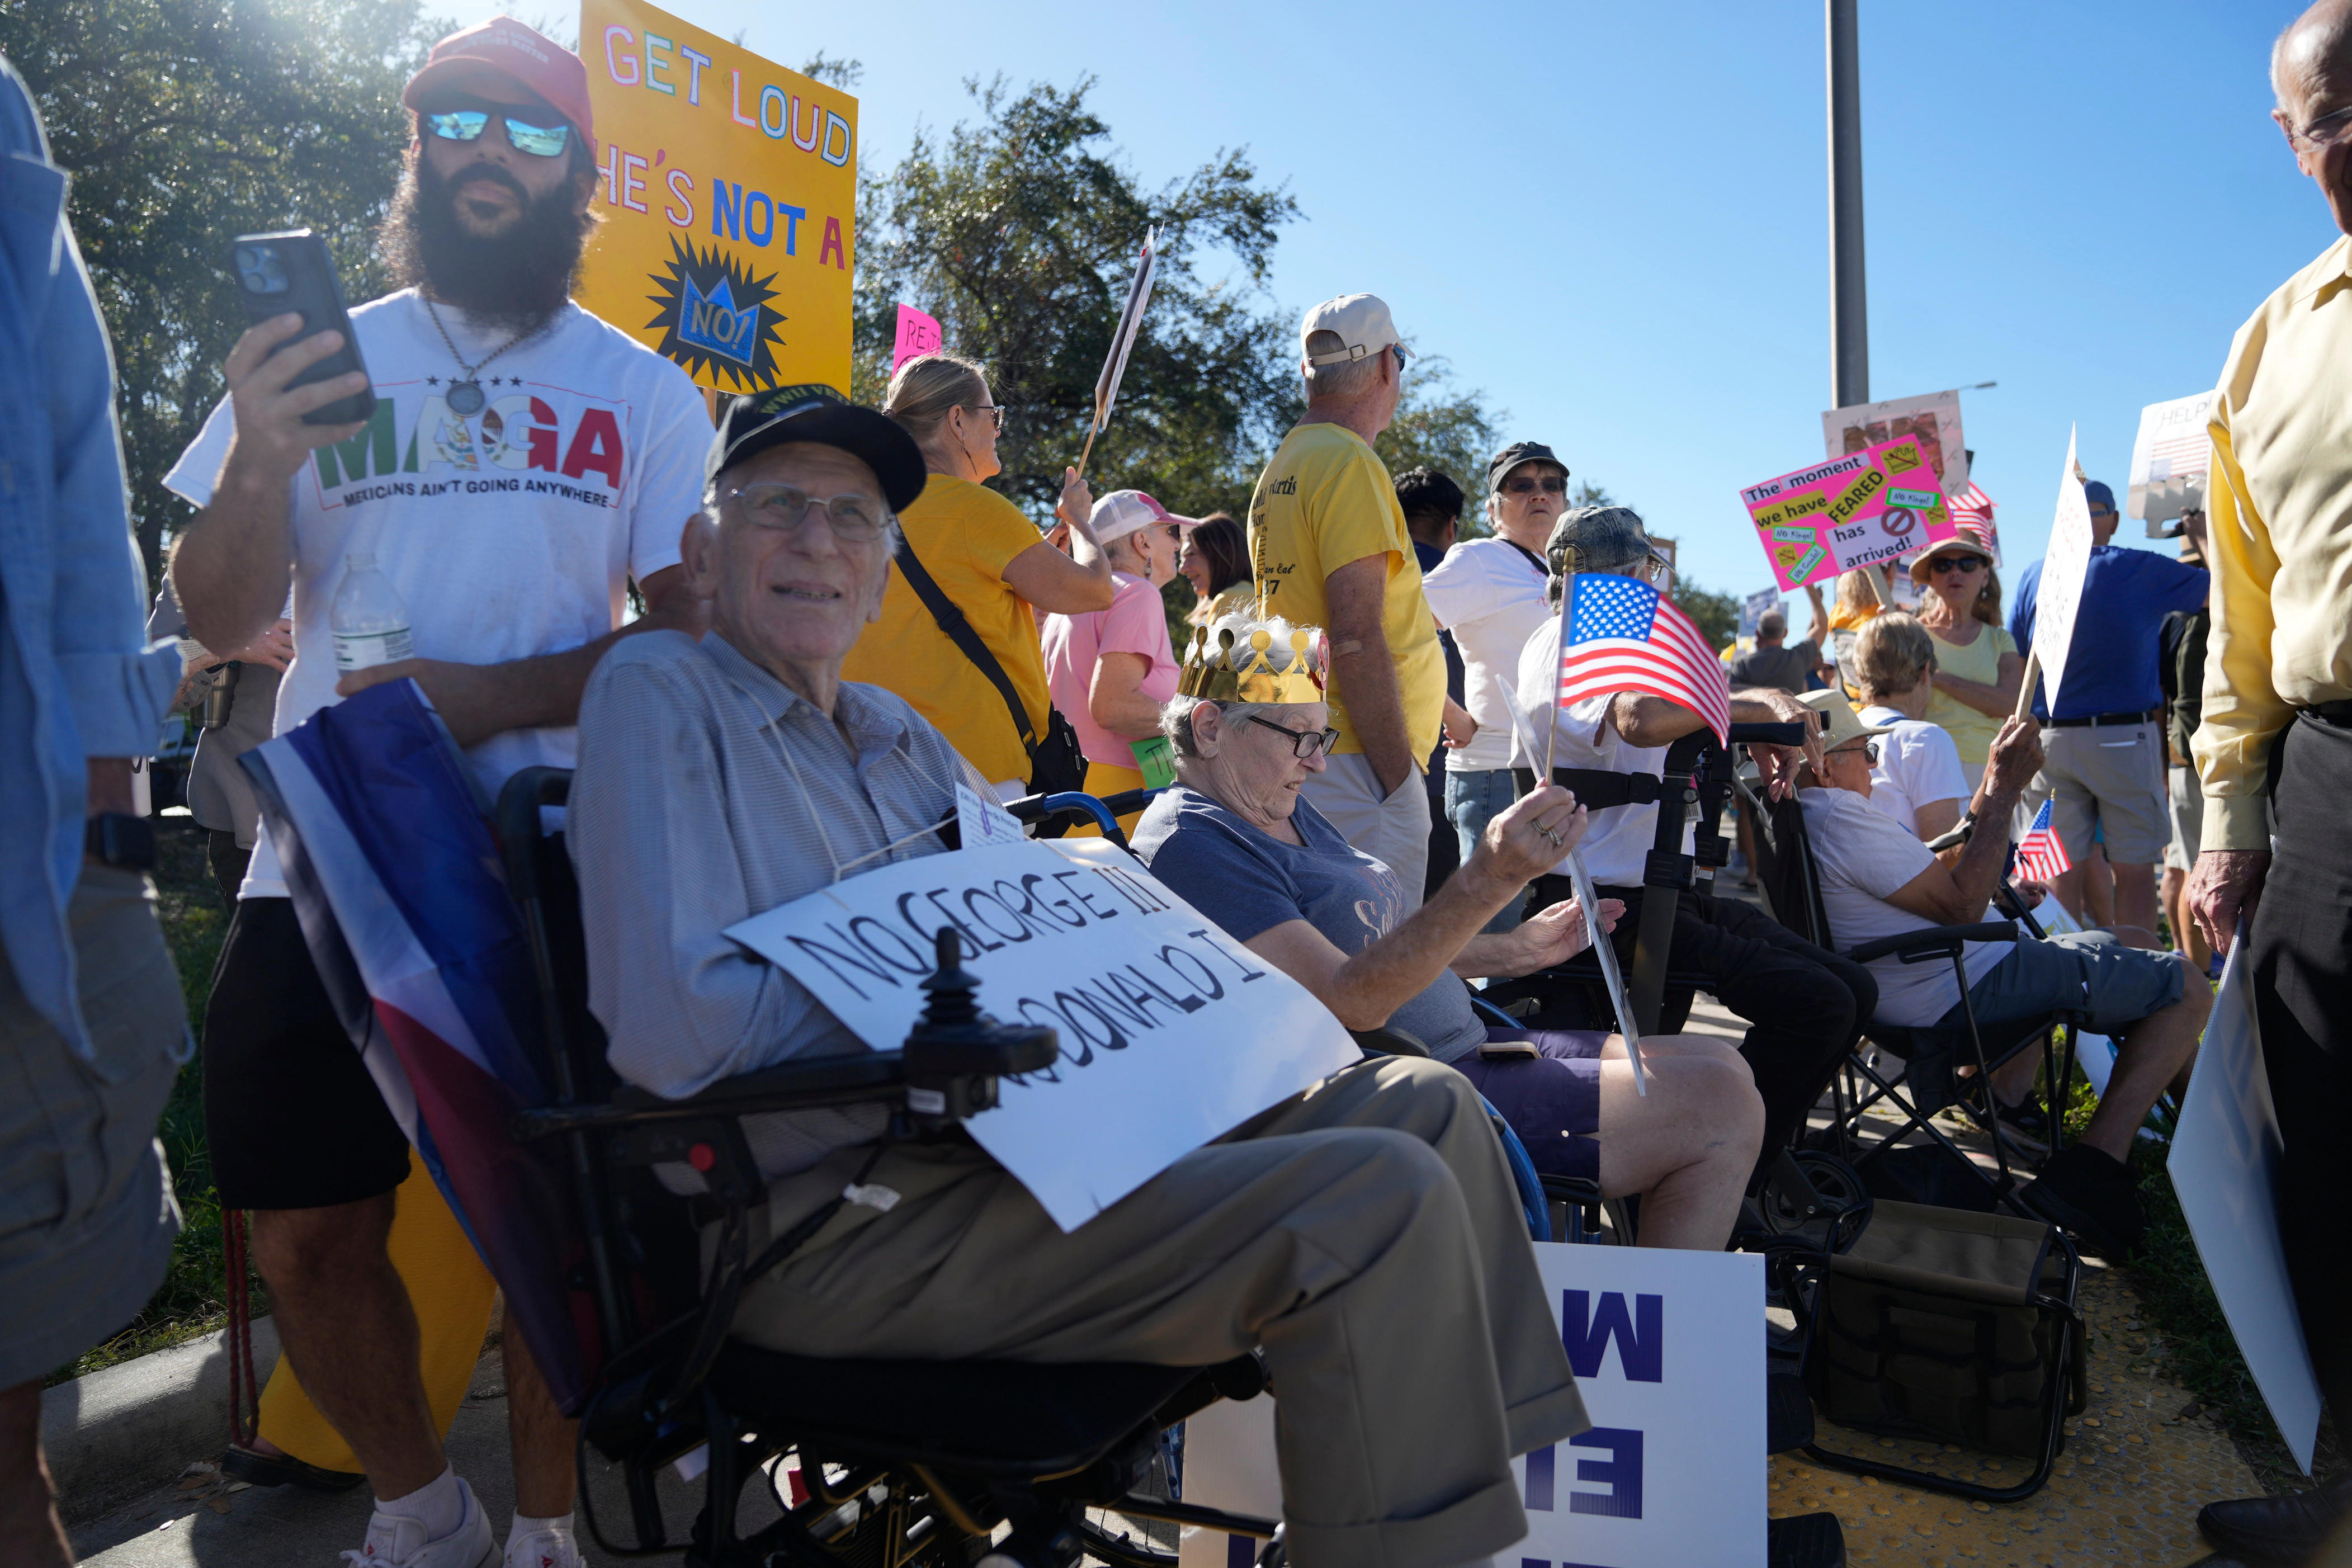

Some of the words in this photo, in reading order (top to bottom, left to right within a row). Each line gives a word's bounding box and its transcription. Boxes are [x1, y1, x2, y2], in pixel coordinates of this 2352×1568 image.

[604, 24, 711, 107] GET
[731, 69, 851, 168] LOUD
[592, 139, 694, 228] HE'S
[711, 178, 806, 257] NOT
[819, 215, 846, 271] A
[691, 299, 752, 350] NO!
[760, 386, 810, 414] WWII
[311, 395, 625, 490] MAGA
[343, 481, 415, 507] MEXICANS
[419, 480, 462, 497] AIN'T
[465, 478, 519, 494] GOING
[525, 479, 610, 508] ANYWHERE
[1747, 484, 1781, 502] The
[1789, 456, 1862, 488] moment
[1827, 470, 1883, 525] FEARED
[1907, 494, 1930, 505] Kings!
[1756, 512, 1782, 528] we
[1784, 497, 1827, 518] have
[1835, 525, 1865, 543] has
[1791, 531, 1812, 542] Kings!
[1846, 536, 1913, 569] arrived!
[786, 915, 936, 1001] NO
[896, 872, 1119, 961] GEORGE
[1093, 866, 1170, 915] III
[1017, 944, 1225, 1067] DONALD
